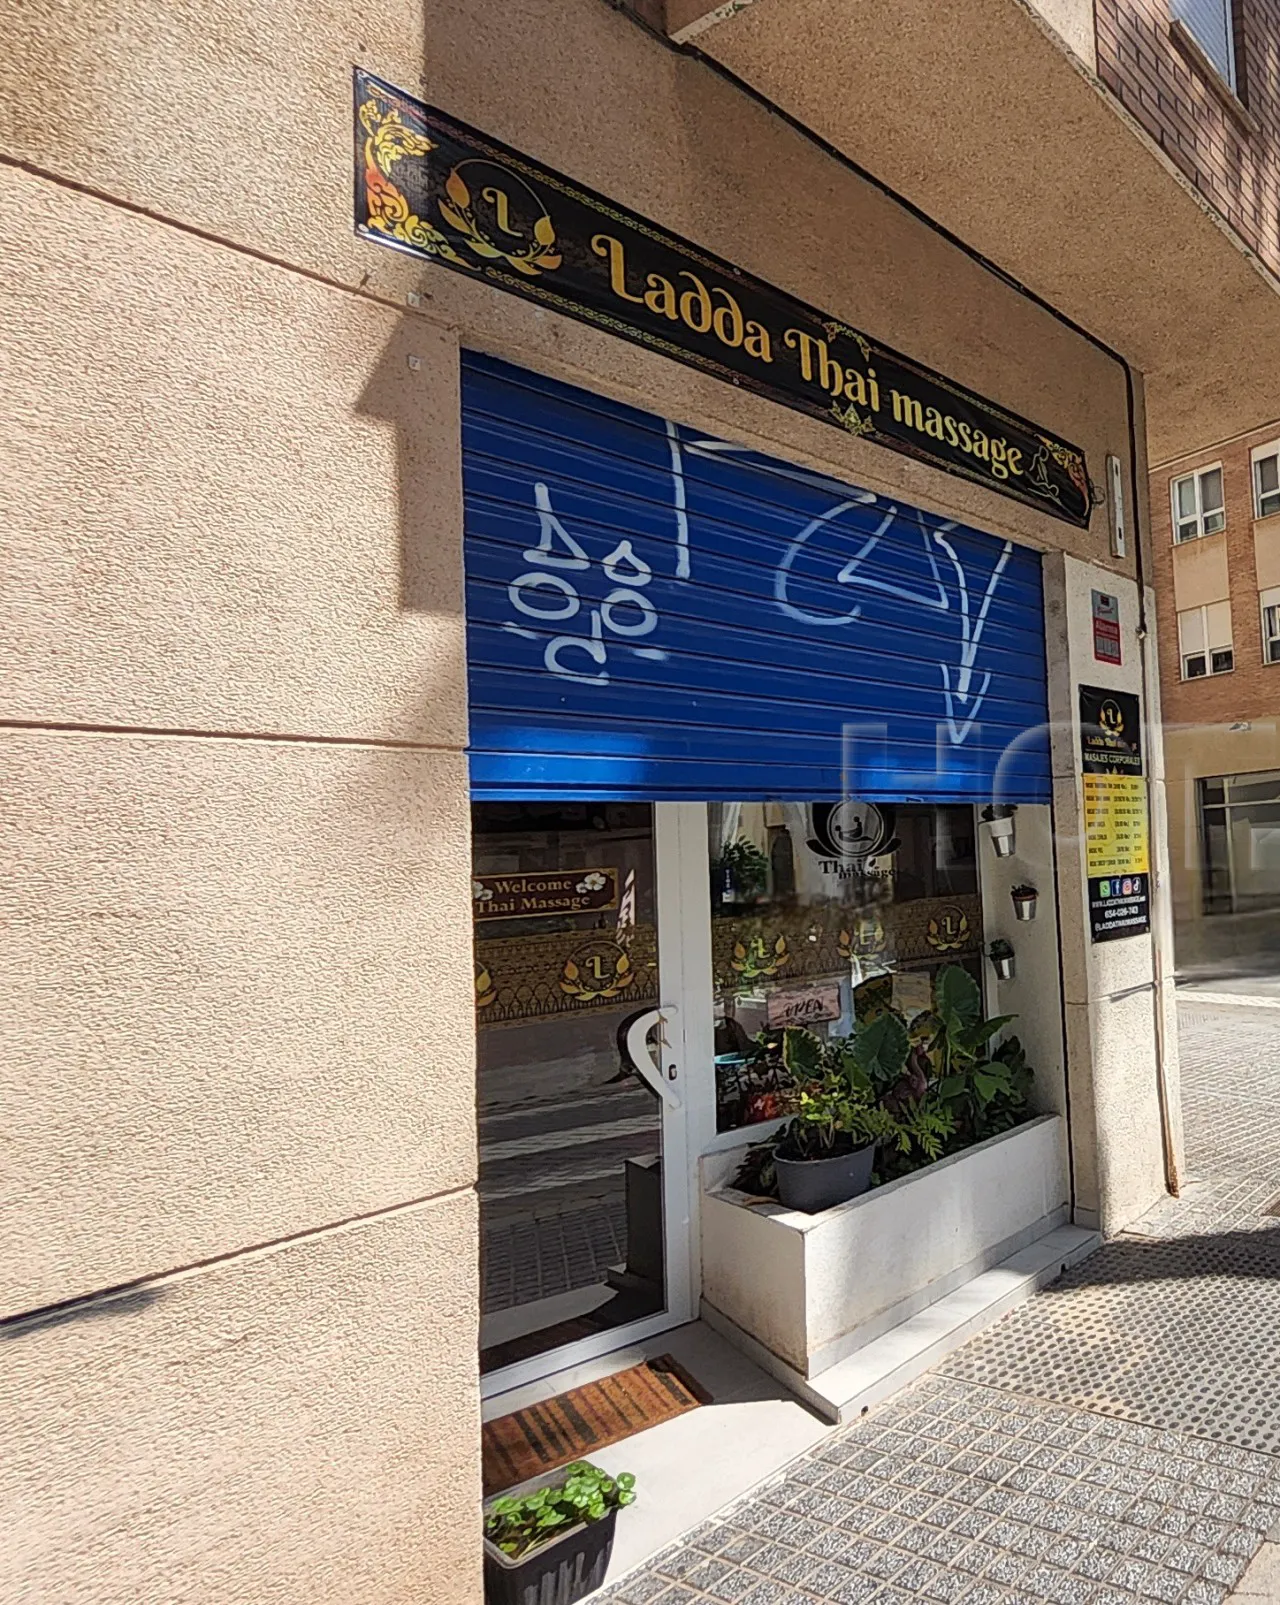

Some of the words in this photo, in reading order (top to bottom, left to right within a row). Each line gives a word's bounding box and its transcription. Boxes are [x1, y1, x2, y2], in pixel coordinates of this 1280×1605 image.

[591, 234, 773, 363] Ladda
[783, 328, 881, 411] Thai
[889, 389, 1024, 479] massage
[818, 859, 864, 875] Thai
[494, 878, 572, 895] Welcome
[476, 897, 515, 913] Thai
[520, 895, 590, 912] Massage
